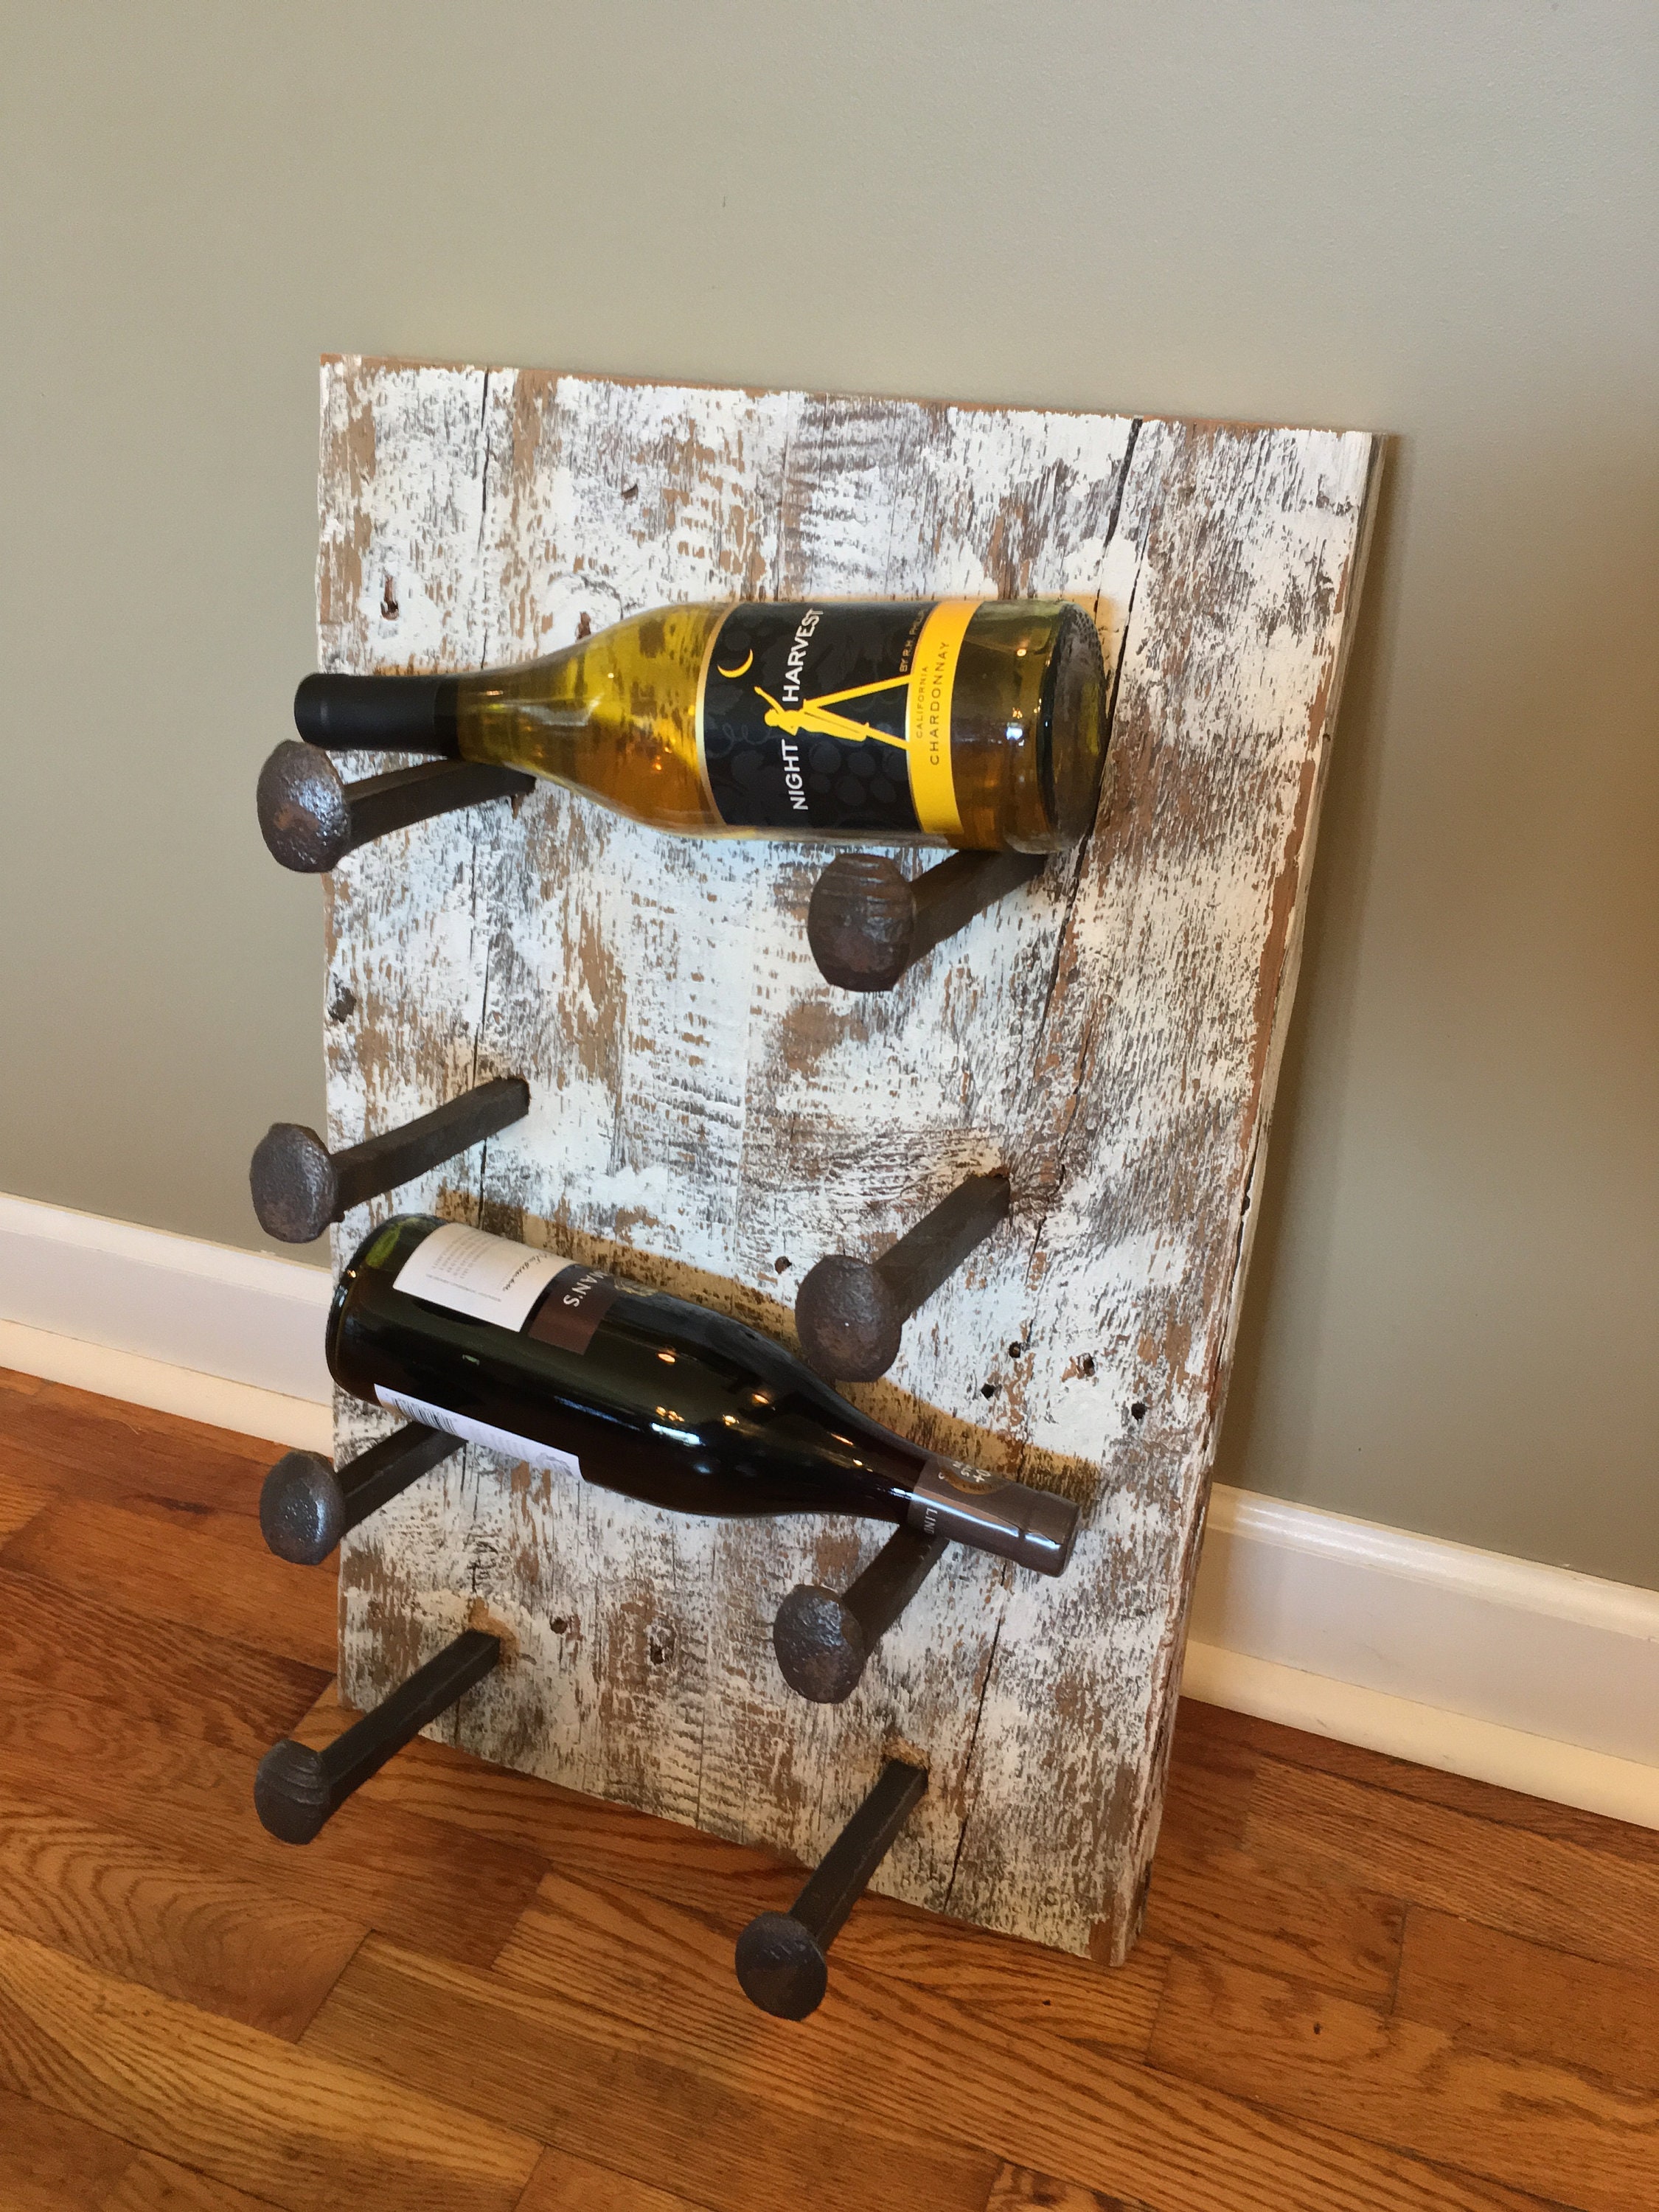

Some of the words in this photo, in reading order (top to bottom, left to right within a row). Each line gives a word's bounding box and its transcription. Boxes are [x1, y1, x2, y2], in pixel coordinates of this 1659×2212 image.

[782, 608, 824, 702] HARVEST
[898, 658, 909, 673] BY
[915, 666, 929, 739] CALIFORNIA
[929, 641, 950, 766] CHARDONNAY
[781, 739, 808, 810] NIGHT
